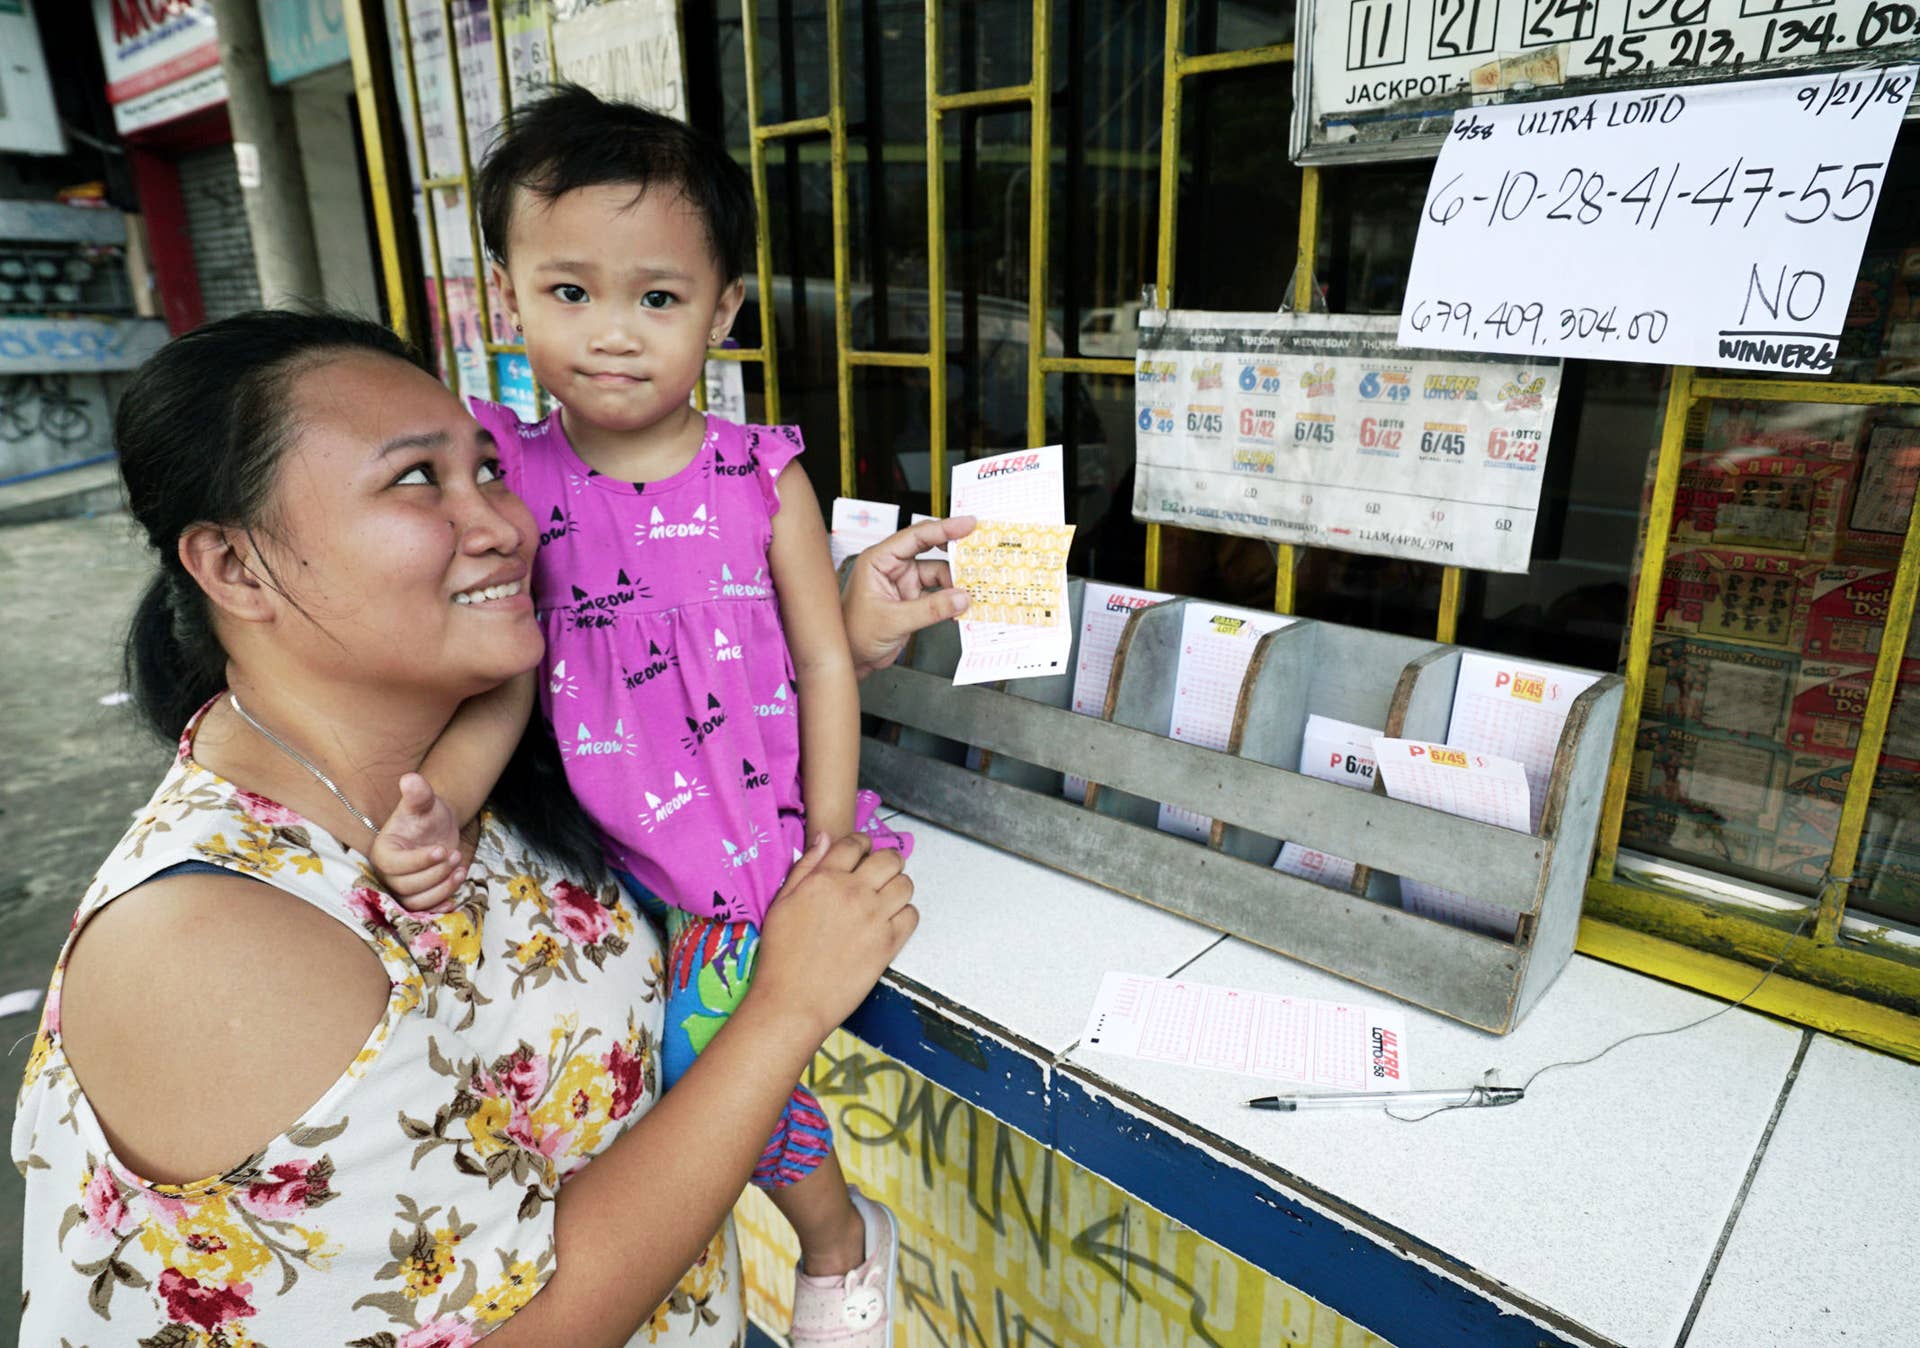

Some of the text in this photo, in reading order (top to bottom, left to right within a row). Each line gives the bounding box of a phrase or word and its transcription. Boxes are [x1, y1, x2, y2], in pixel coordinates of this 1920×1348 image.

[1360, 3, 1391, 68] 11
[1346, 74, 1451, 104] JACKPOT
[1518, 98, 1598, 137] ULTRA
[1607, 92, 1686, 128] LOTTO
[1797, 67, 1912, 119] 9/21/18
[1739, 262, 1826, 326] NO
[1241, 335, 1281, 346] TUESDAY
[1360, 371, 1411, 402] 6/49
[1187, 412, 1223, 433] 6/45
[1240, 408, 1274, 438] 6/42
[1294, 422, 1335, 444] 6/45
[1360, 417, 1402, 450] 6/42
[1421, 432, 1465, 456] 6/45
[977, 454, 1039, 474] ULTRA
[649, 523, 706, 539] meow
[1495, 519, 1512, 532] 6D
[1359, 529, 1454, 552] 11AM/4PM/9PM
[576, 590, 635, 613] meow
[717, 646, 743, 661] me
[1513, 678, 1543, 699] 6/45
[576, 741, 623, 756] meow
[1430, 750, 1467, 766] 6/45
[1345, 755, 1374, 778] 6/42
[746, 773, 769, 790] me
[656, 788, 693, 823] meow
[733, 843, 759, 868] meo
[1382, 1029, 1399, 1080] ULTRA
